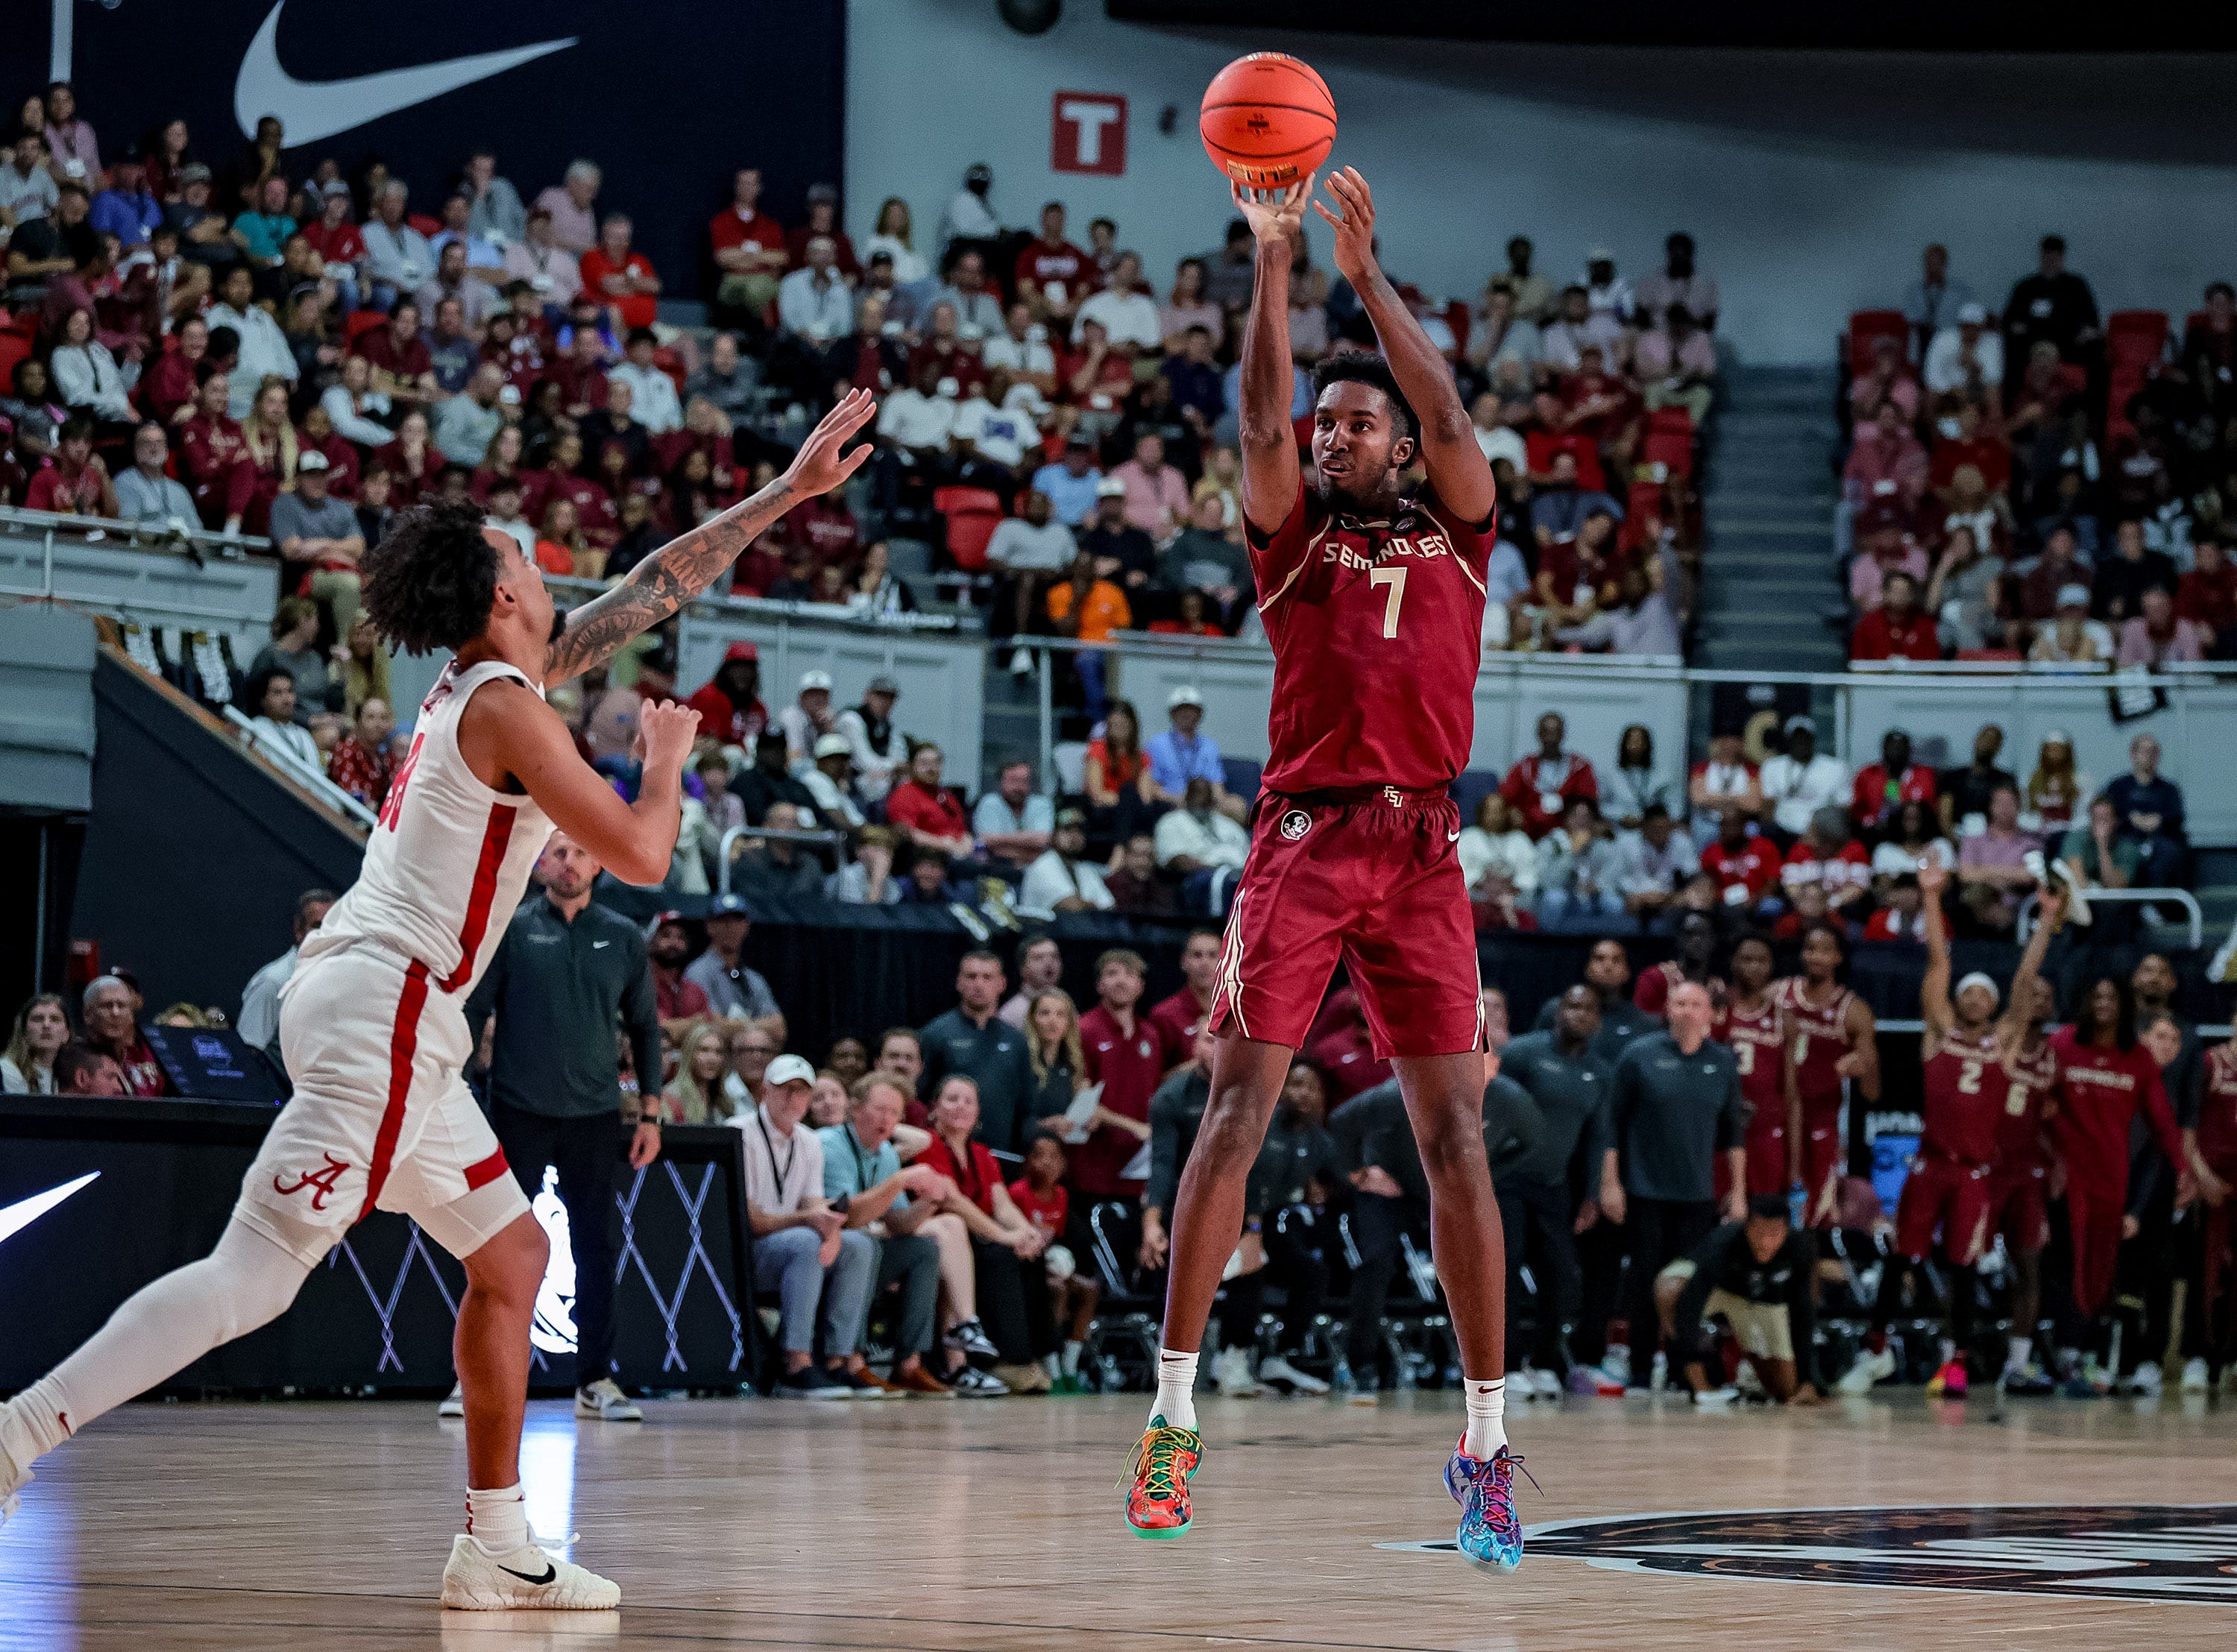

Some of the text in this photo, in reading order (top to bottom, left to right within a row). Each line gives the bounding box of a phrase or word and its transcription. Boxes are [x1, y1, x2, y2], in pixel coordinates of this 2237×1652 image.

[1062, 101, 1118, 164] T
[1370, 567, 1407, 639] 7
[1384, 786, 1403, 807] FSU
[1957, 1061, 1982, 1094] 2
